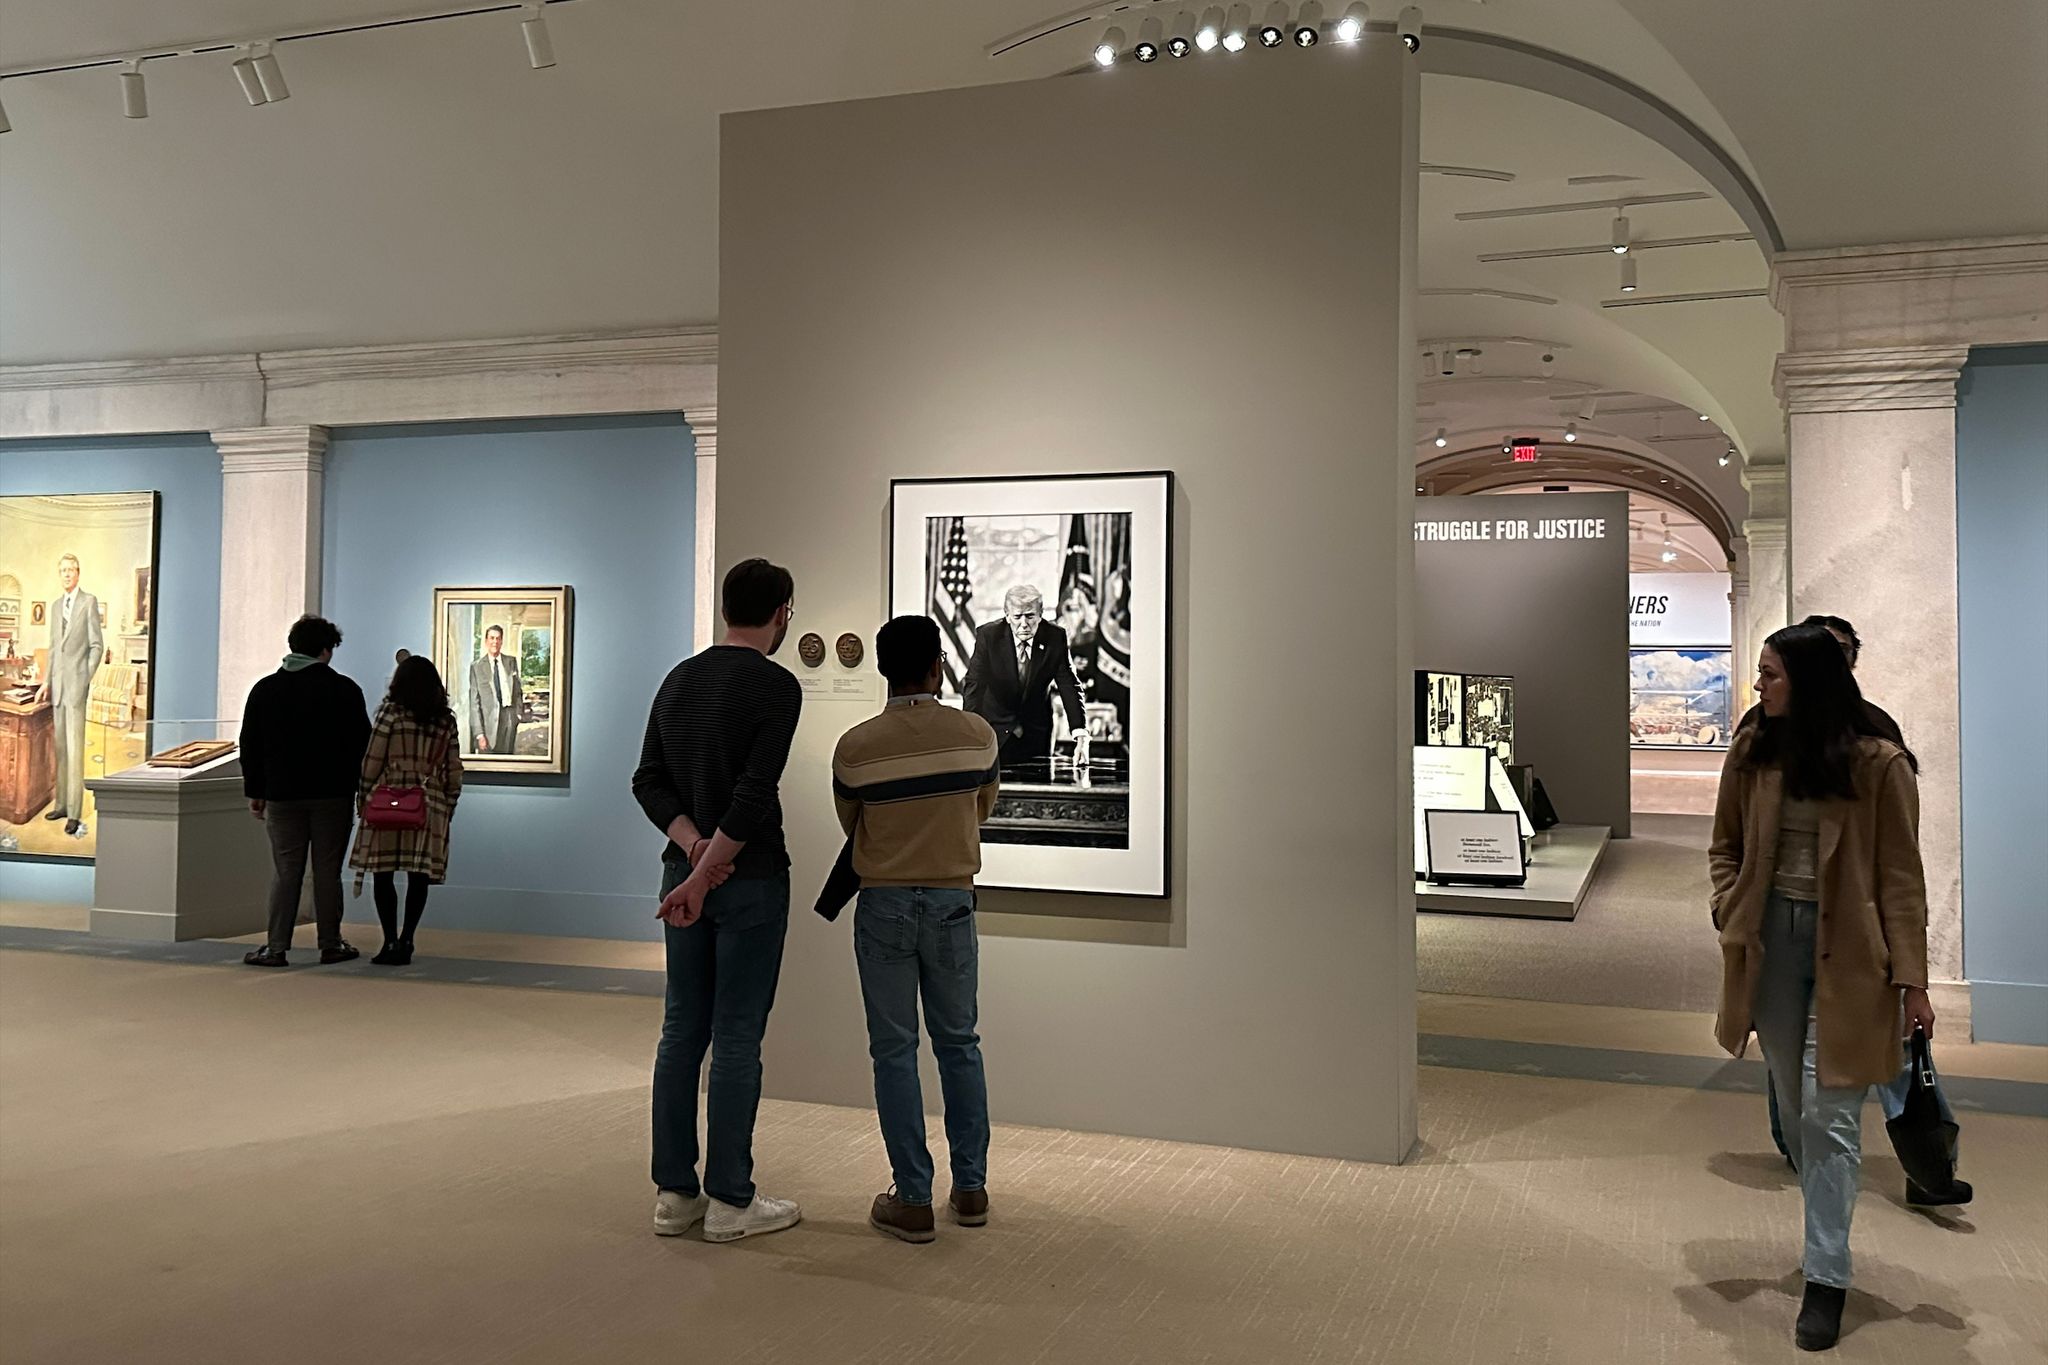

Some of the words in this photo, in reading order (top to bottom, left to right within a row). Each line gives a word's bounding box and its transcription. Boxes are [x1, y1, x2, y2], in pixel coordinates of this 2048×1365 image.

[1514, 446, 1536, 462] EXIT
[1495, 519, 1529, 540] FOR
[1533, 518, 1605, 540] JUSTICE
[1640, 619, 1662, 628] NATION
